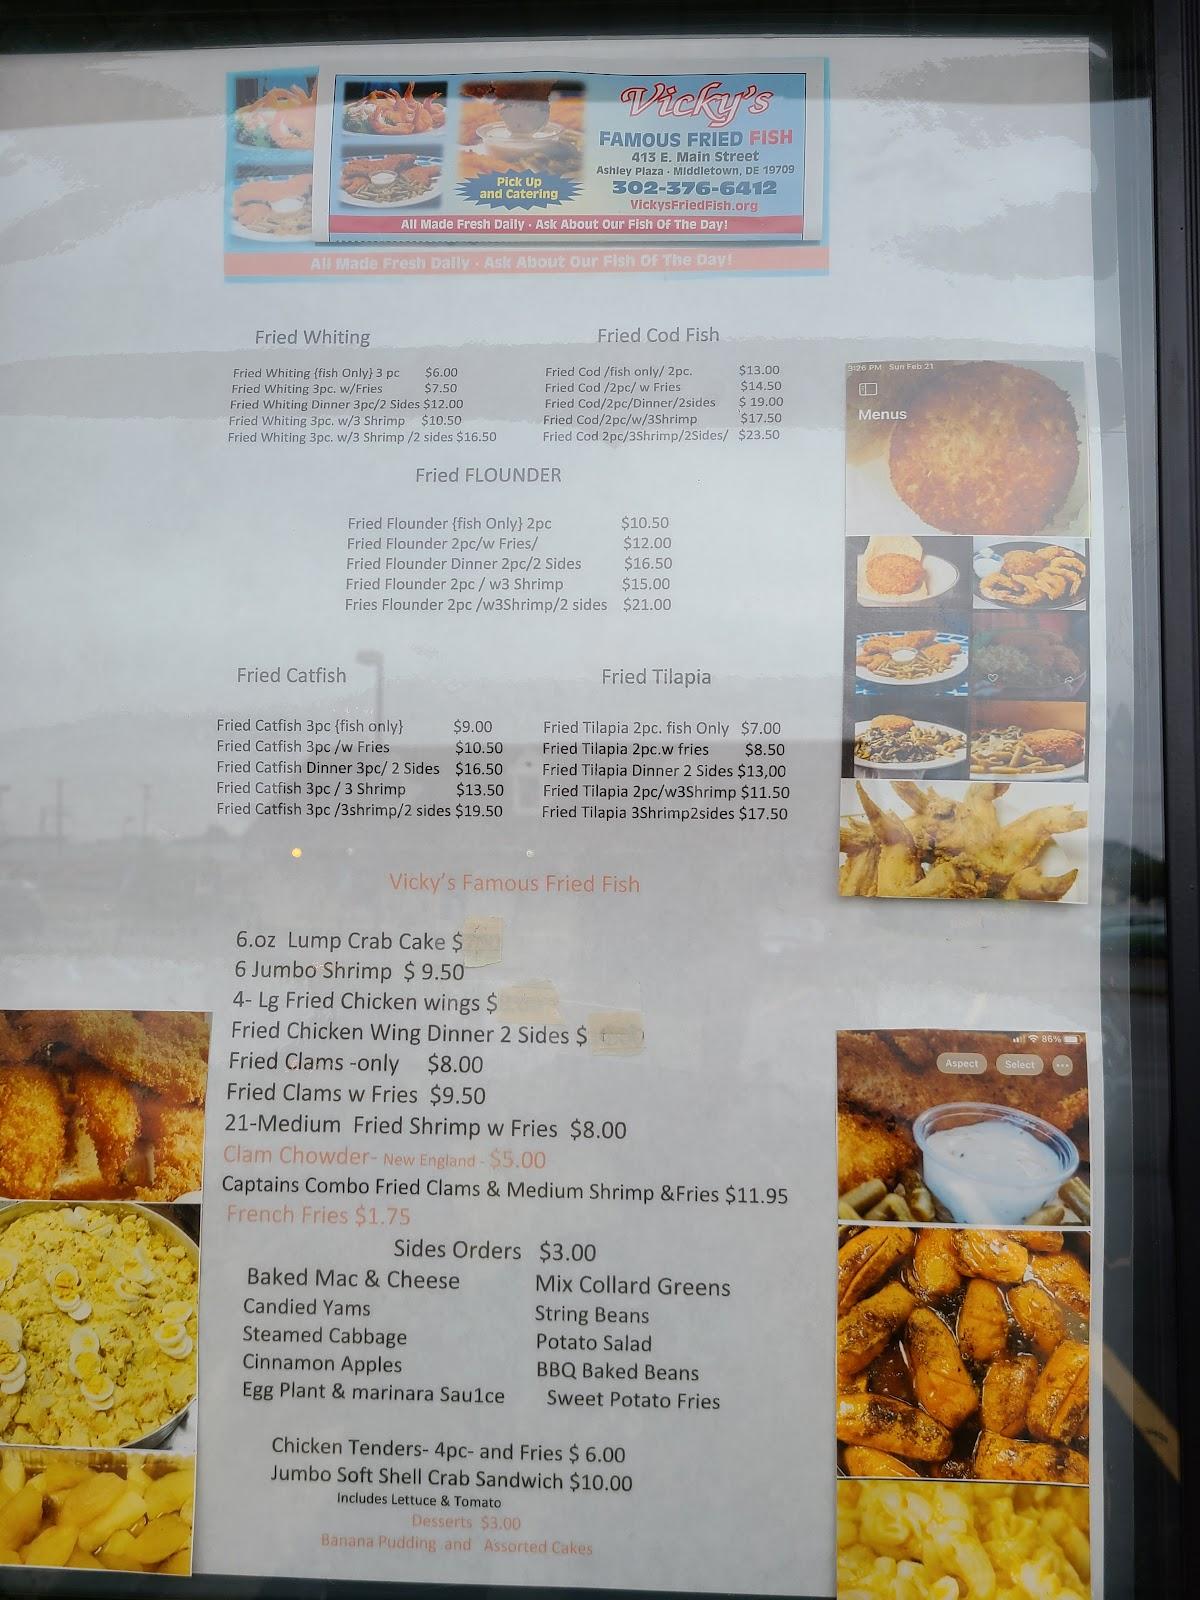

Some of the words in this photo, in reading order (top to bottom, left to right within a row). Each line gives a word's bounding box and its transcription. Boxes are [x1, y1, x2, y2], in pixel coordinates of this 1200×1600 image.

[620, 82, 774, 128] Vicky's
[599, 130, 680, 147] FAMOUS
[687, 131, 743, 147] FRIED
[751, 129, 792, 144] FISH
[631, 151, 655, 162] 413
[660, 151, 671, 162] E.
[676, 150, 710, 162] Main
[714, 150, 759, 162] Street
[596, 165, 632, 176] Ashley
[635, 166, 663, 175] Plaza
[673, 166, 742, 176] Middletown,
[745, 166, 759, 175] DE
[762, 164, 794, 174] 19709
[497, 176, 522, 186] Pick
[525, 177, 541, 188] Up
[612, 180, 776, 195] 302-376-6412
[479, 188, 502, 198] and
[505, 188, 558, 200] Catering
[630, 199, 757, 212] VickysFriedFish.org
[401, 218, 416, 229] All
[421, 219, 452, 230] Made
[457, 218, 490, 229] Fresh
[494, 218, 524, 231] Daily
[535, 219, 557, 229] Ask
[560, 218, 598, 229] About
[602, 219, 624, 229] Our
[628, 218, 652, 229] Fish
[656, 218, 671, 229] Of
[673, 218, 696, 229] The
[700, 219, 727, 231] Day!
[255, 329, 297, 344] Fried
[303, 328, 370, 347] Whiting
[597, 327, 640, 343] Fried
[646, 326, 679, 342] Cod
[686, 326, 719, 342] Fish
[233, 368, 261, 378] Fried
[265, 367, 311, 380] Whiting
[313, 367, 337, 379] {fish
[342, 367, 373, 379] Only}
[375, 368, 382, 377] 3
[386, 370, 399, 379] pc
[424, 366, 457, 378] $6.00
[889, 363, 905, 371] Sun
[545, 382, 574, 392] Fried
[578, 382, 600, 392] Cod
[603, 381, 636, 394] /2pc/
[639, 384, 649, 392] w
[653, 381, 680, 392] Fries
[740, 380, 781, 392] $14.50
[230, 399, 259, 409] Fried
[262, 399, 307, 411] Whiting
[311, 399, 350, 409] Dinner
[353, 398, 386, 411] 3pc/2
[389, 399, 420, 409] Sides
[423, 397, 463, 410] $12.00
[858, 409, 908, 421] Menus
[543, 430, 572, 441] Fried
[576, 430, 598, 441] Cod
[602, 428, 728, 443] 2pc/3Shrimp/2Sides/
[738, 428, 780, 441] $23.50
[416, 466, 459, 482] Fried
[465, 467, 561, 482] FLOUNDER
[348, 516, 382, 529] Fried
[387, 516, 448, 529] Flounder
[452, 516, 481, 531] {fish
[485, 516, 523, 532] Only}
[526, 517, 551, 532] 2pc
[621, 515, 669, 531] $10.50
[345, 598, 377, 610] Fries
[382, 597, 444, 610] Flounder
[447, 598, 472, 613] 2pc
[475, 596, 568, 613] /w3Shrimp/2
[572, 597, 607, 610] sides
[623, 596, 671, 612] $21.00
[237, 666, 280, 682] Fried
[286, 666, 346, 683] Catfish
[602, 667, 646, 684] Fried
[651, 667, 711, 688] Tilapia
[543, 741, 577, 754] Fried
[581, 742, 627, 758] Tilapia
[632, 742, 673, 758] 2pc.w
[677, 742, 708, 755] fries
[745, 742, 784, 757] $8.50
[217, 760, 250, 773] Fried
[255, 760, 301, 773] Catfish
[306, 761, 352, 774] Dinner
[356, 760, 387, 777] 3pc/
[391, 761, 399, 774] 2
[403, 761, 439, 774] Sides
[455, 761, 502, 776] $16.50
[543, 784, 578, 797] Fried
[582, 784, 628, 800] Tilapia
[633, 783, 736, 801] 2pc/w3Shrimp
[740, 784, 789, 800] $11.50
[389, 872, 455, 894] Vicky's
[463, 873, 539, 892] Famous
[546, 874, 594, 892] Fried
[602, 874, 639, 893] Fish
[235, 960, 246, 977] 6
[251, 960, 316, 978] Jumbo
[322, 961, 391, 984] Shrimp
[403, 960, 414, 982] $
[422, 963, 465, 980] 9.50
[1041, 1035, 1062, 1044] 86%
[945, 1059, 979, 1069] Aspect
[1005, 1060, 1035, 1070] Select
[224, 1113, 340, 1133] 21-Medium
[354, 1115, 402, 1134] Fried
[409, 1116, 480, 1140] Shrimp
[487, 1123, 504, 1136] w
[511, 1119, 557, 1138] Fries
[570, 1117, 626, 1141] $8.00
[222, 1175, 299, 1196] Captains
[305, 1176, 369, 1194] Combo
[376, 1177, 419, 1195] Fried
[426, 1178, 480, 1196] Clams
[486, 1180, 500, 1197] &
[507, 1181, 583, 1199] Medium
[589, 1182, 654, 1205] Shrimp
[660, 1184, 719, 1202] &Fries
[725, 1184, 787, 1205] $11.95
[393, 1238, 445, 1258] Sides
[452, 1240, 521, 1260] Orders
[539, 1240, 596, 1263] $3.00
[536, 1274, 572, 1292] Mix
[579, 1274, 650, 1294] Collard
[657, 1277, 730, 1296] Greens
[243, 1297, 316, 1315] Candied
[323, 1299, 370, 1316] Yams
[243, 1381, 273, 1401] Egg
[280, 1380, 325, 1398] Plant
[331, 1382, 345, 1399] &
[352, 1384, 433, 1401] marinara
[440, 1386, 504, 1403] Sau1ce
[270, 1464, 331, 1482] Jumbo
[337, 1466, 373, 1483] Soft
[378, 1467, 421, 1484] Shell
[428, 1469, 469, 1486] Crab
[475, 1470, 562, 1489] Sandwich
[569, 1471, 632, 1492] $10.00
[337, 1492, 387, 1504] Includes
[391, 1493, 436, 1506] Lettuce
[440, 1494, 450, 1506] &
[453, 1495, 501, 1508] Tomato
[412, 1513, 472, 1528] Desserts
[481, 1514, 521, 1531] $3.00
